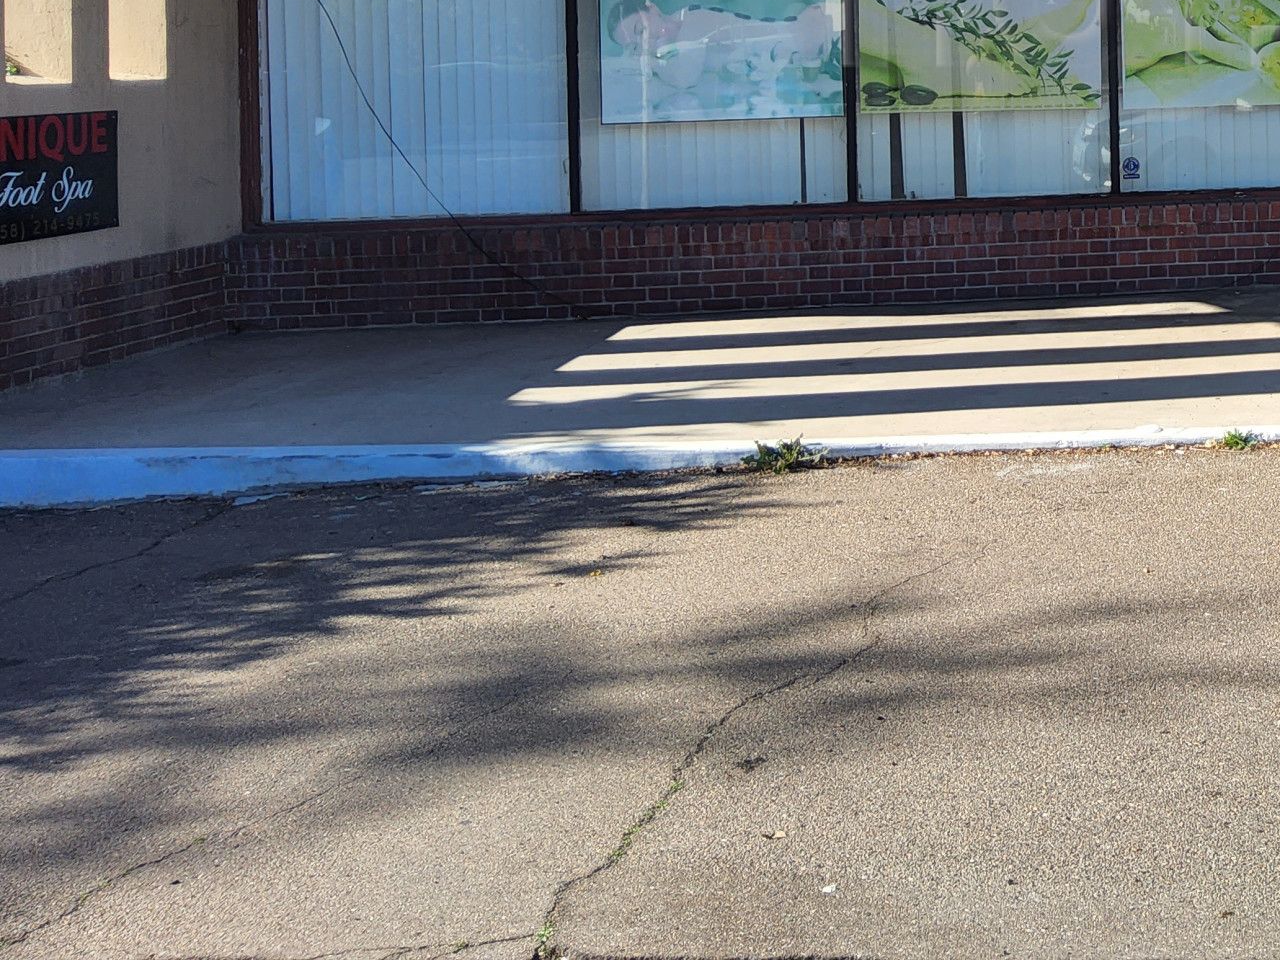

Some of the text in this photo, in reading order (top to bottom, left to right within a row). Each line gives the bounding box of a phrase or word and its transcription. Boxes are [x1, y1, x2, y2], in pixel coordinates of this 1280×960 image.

[0, 112, 108, 163] NIQUE
[0, 166, 93, 213] Foot Spa
[0, 222, 25, 240] 58)
